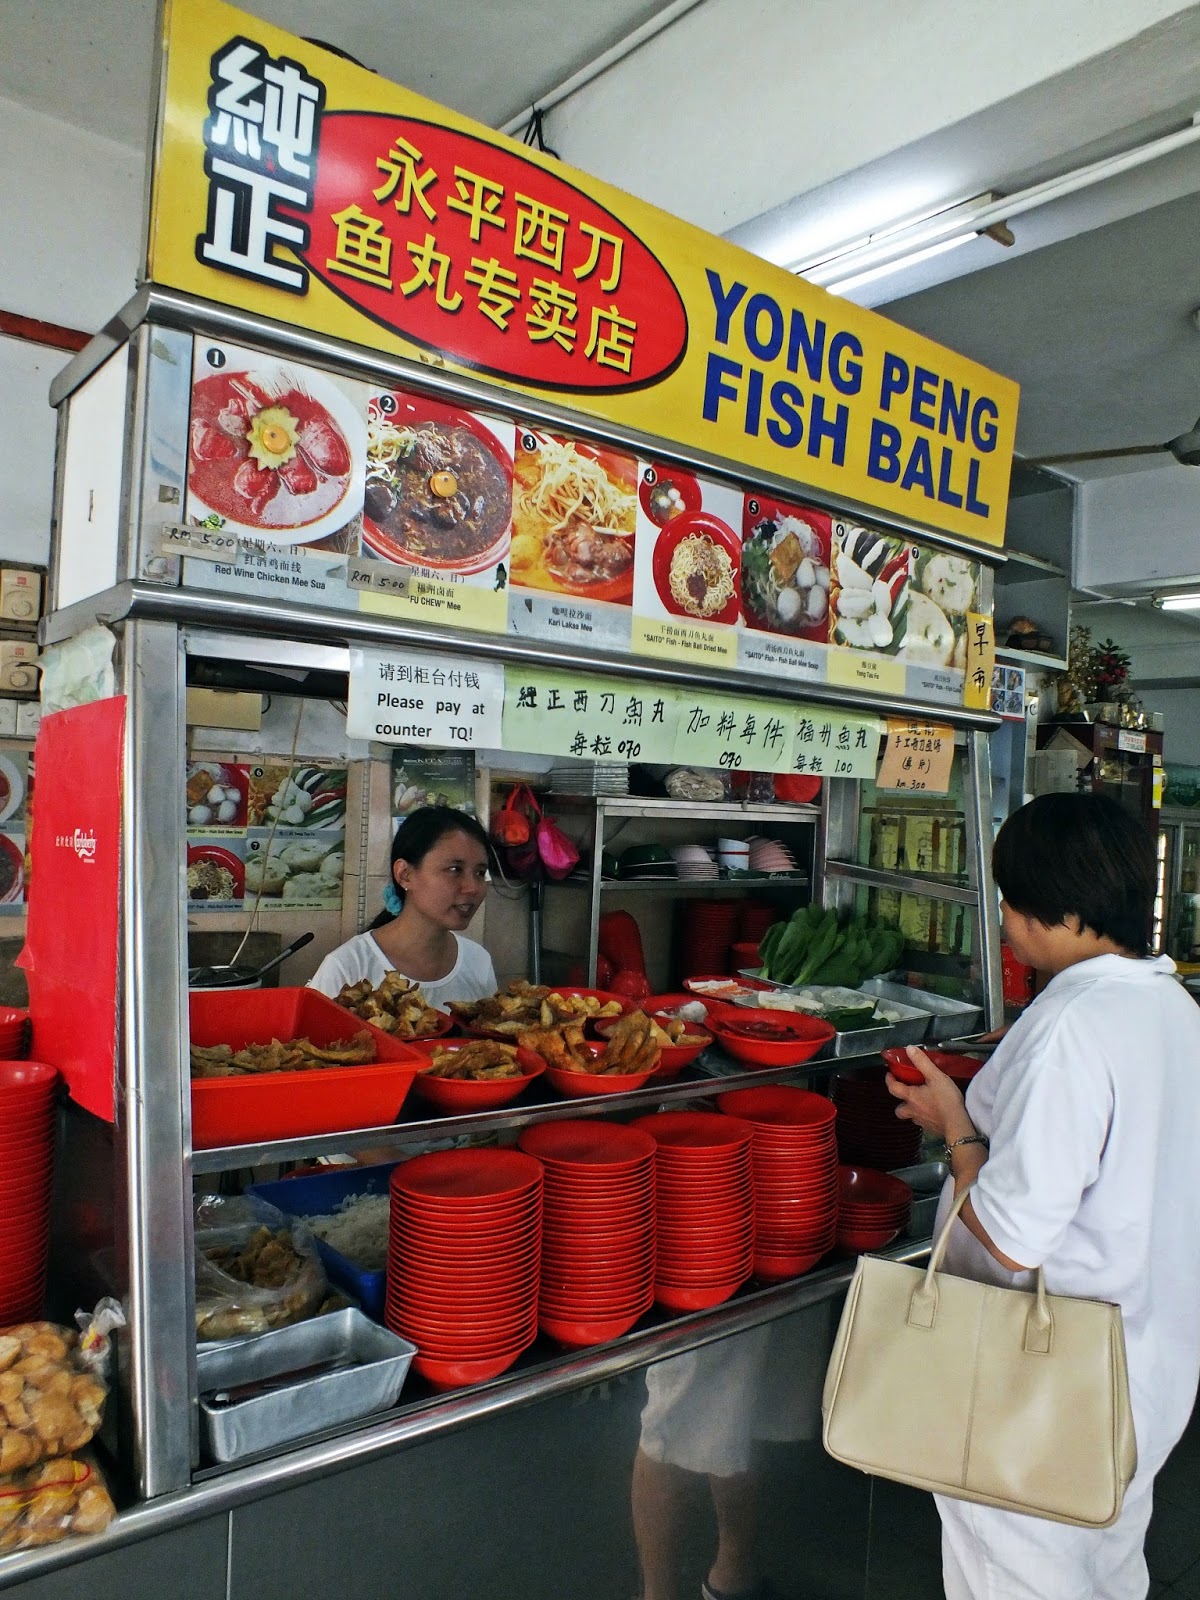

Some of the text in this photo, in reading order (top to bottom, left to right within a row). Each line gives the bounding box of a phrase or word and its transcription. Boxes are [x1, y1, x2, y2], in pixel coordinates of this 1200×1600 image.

[198, 38, 324, 294] 純正
[373, 137, 624, 292] 永平西刀
[326, 205, 637, 375] 鱼丸专卖店
[705, 268, 999, 454] YONG PENG
[702, 351, 990, 518] FISH BALL
[200, 533, 235, 547] 5.00
[215, 565, 326, 590] Red Wine Chicken Mee Sua
[447, 601, 461, 610] Mee
[548, 618, 592, 632] Kari Laksa Mee
[665, 637, 676, 646] Fish
[681, 640, 692, 648] Fish
[693, 642, 702, 650] Ball
[703, 644, 716, 652] Dried
[717, 646, 727, 654] Mee
[378, 662, 481, 689] 请到柜台付钱
[377, 693, 485, 715] Please pay at
[375, 722, 473, 742] counter TQ!
